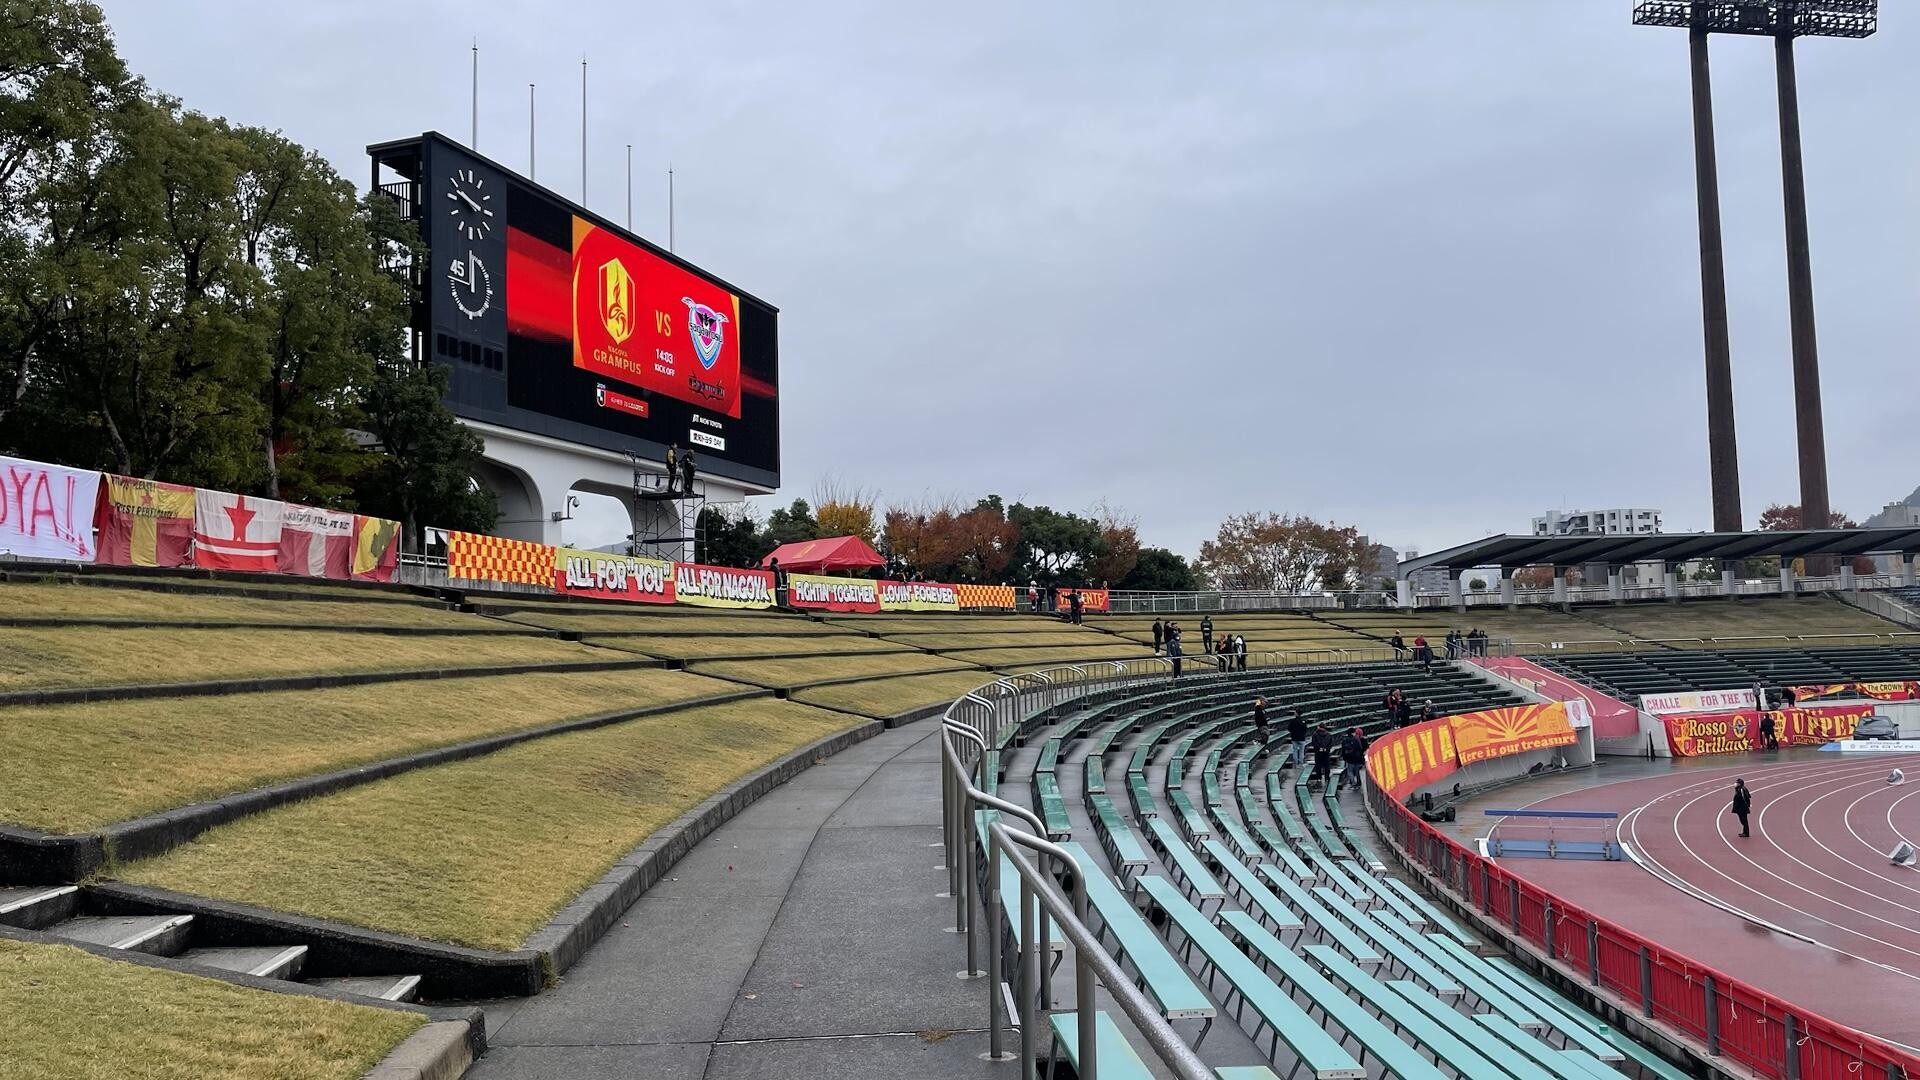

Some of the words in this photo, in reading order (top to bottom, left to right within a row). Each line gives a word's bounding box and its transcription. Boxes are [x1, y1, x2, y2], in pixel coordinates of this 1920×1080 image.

[450, 259, 465, 277] 45
[655, 309, 672, 337] VS
[593, 348, 642, 375] GRAMPUS
[565, 556, 597, 590] ALL
[596, 559, 629, 592] FOR
[677, 566, 700, 596] ALL
[699, 569, 722, 600] FOR
[720, 572, 771, 603] NAGOYA
[831, 584, 876, 604] TOGETHER
[912, 584, 956, 605] FOREVER
[1880, 683, 1903, 691] CROWN
[1700, 694, 1719, 707] FOR
[1721, 692, 1741, 704] THE
[1688, 719, 1728, 737] Rosso
[1459, 749, 1484, 764] Here
[1486, 745, 1497, 757] is
[1500, 743, 1520, 755] our
[1521, 734, 1576, 750] treasure
